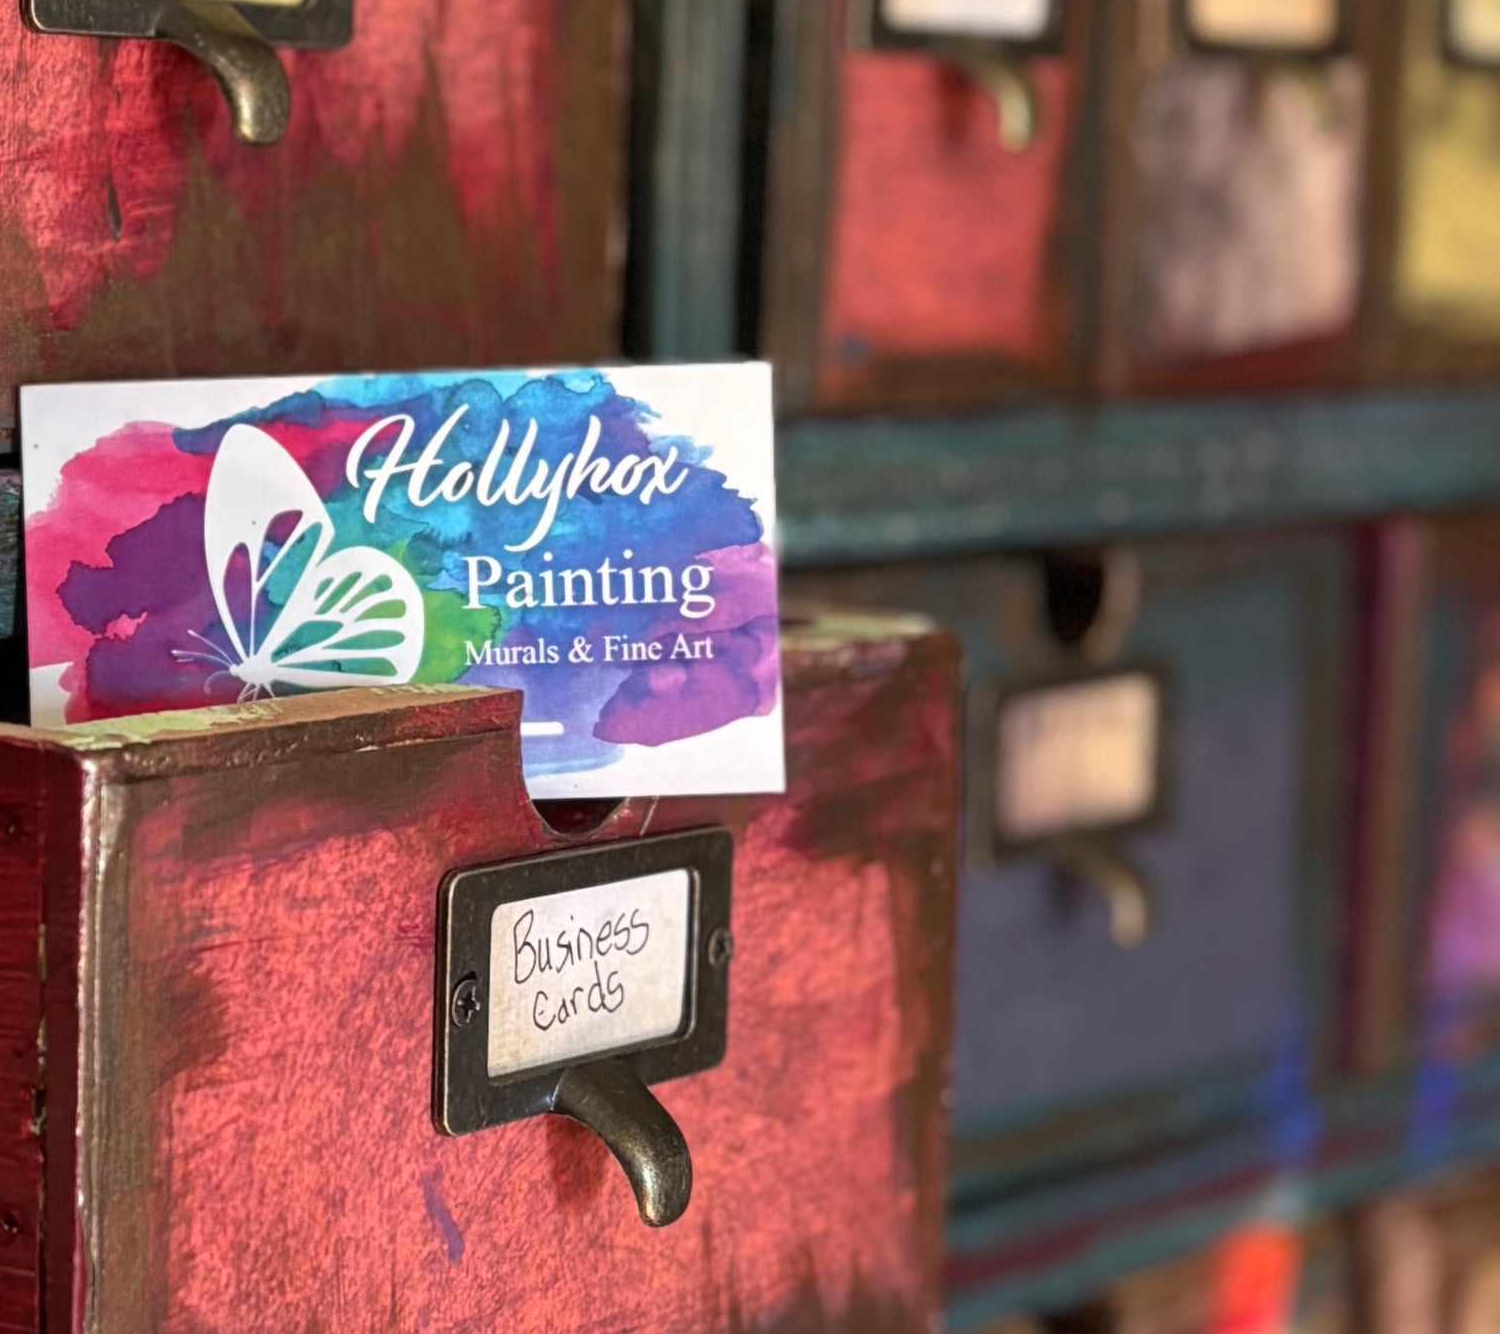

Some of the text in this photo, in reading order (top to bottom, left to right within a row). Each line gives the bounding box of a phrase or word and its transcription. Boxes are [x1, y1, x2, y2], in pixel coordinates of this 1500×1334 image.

[345, 402, 690, 553] Hollyhox
[461, 548, 716, 619] Painting
[463, 632, 715, 666] Murals & Fine Art
[512, 908, 650, 985] Business
